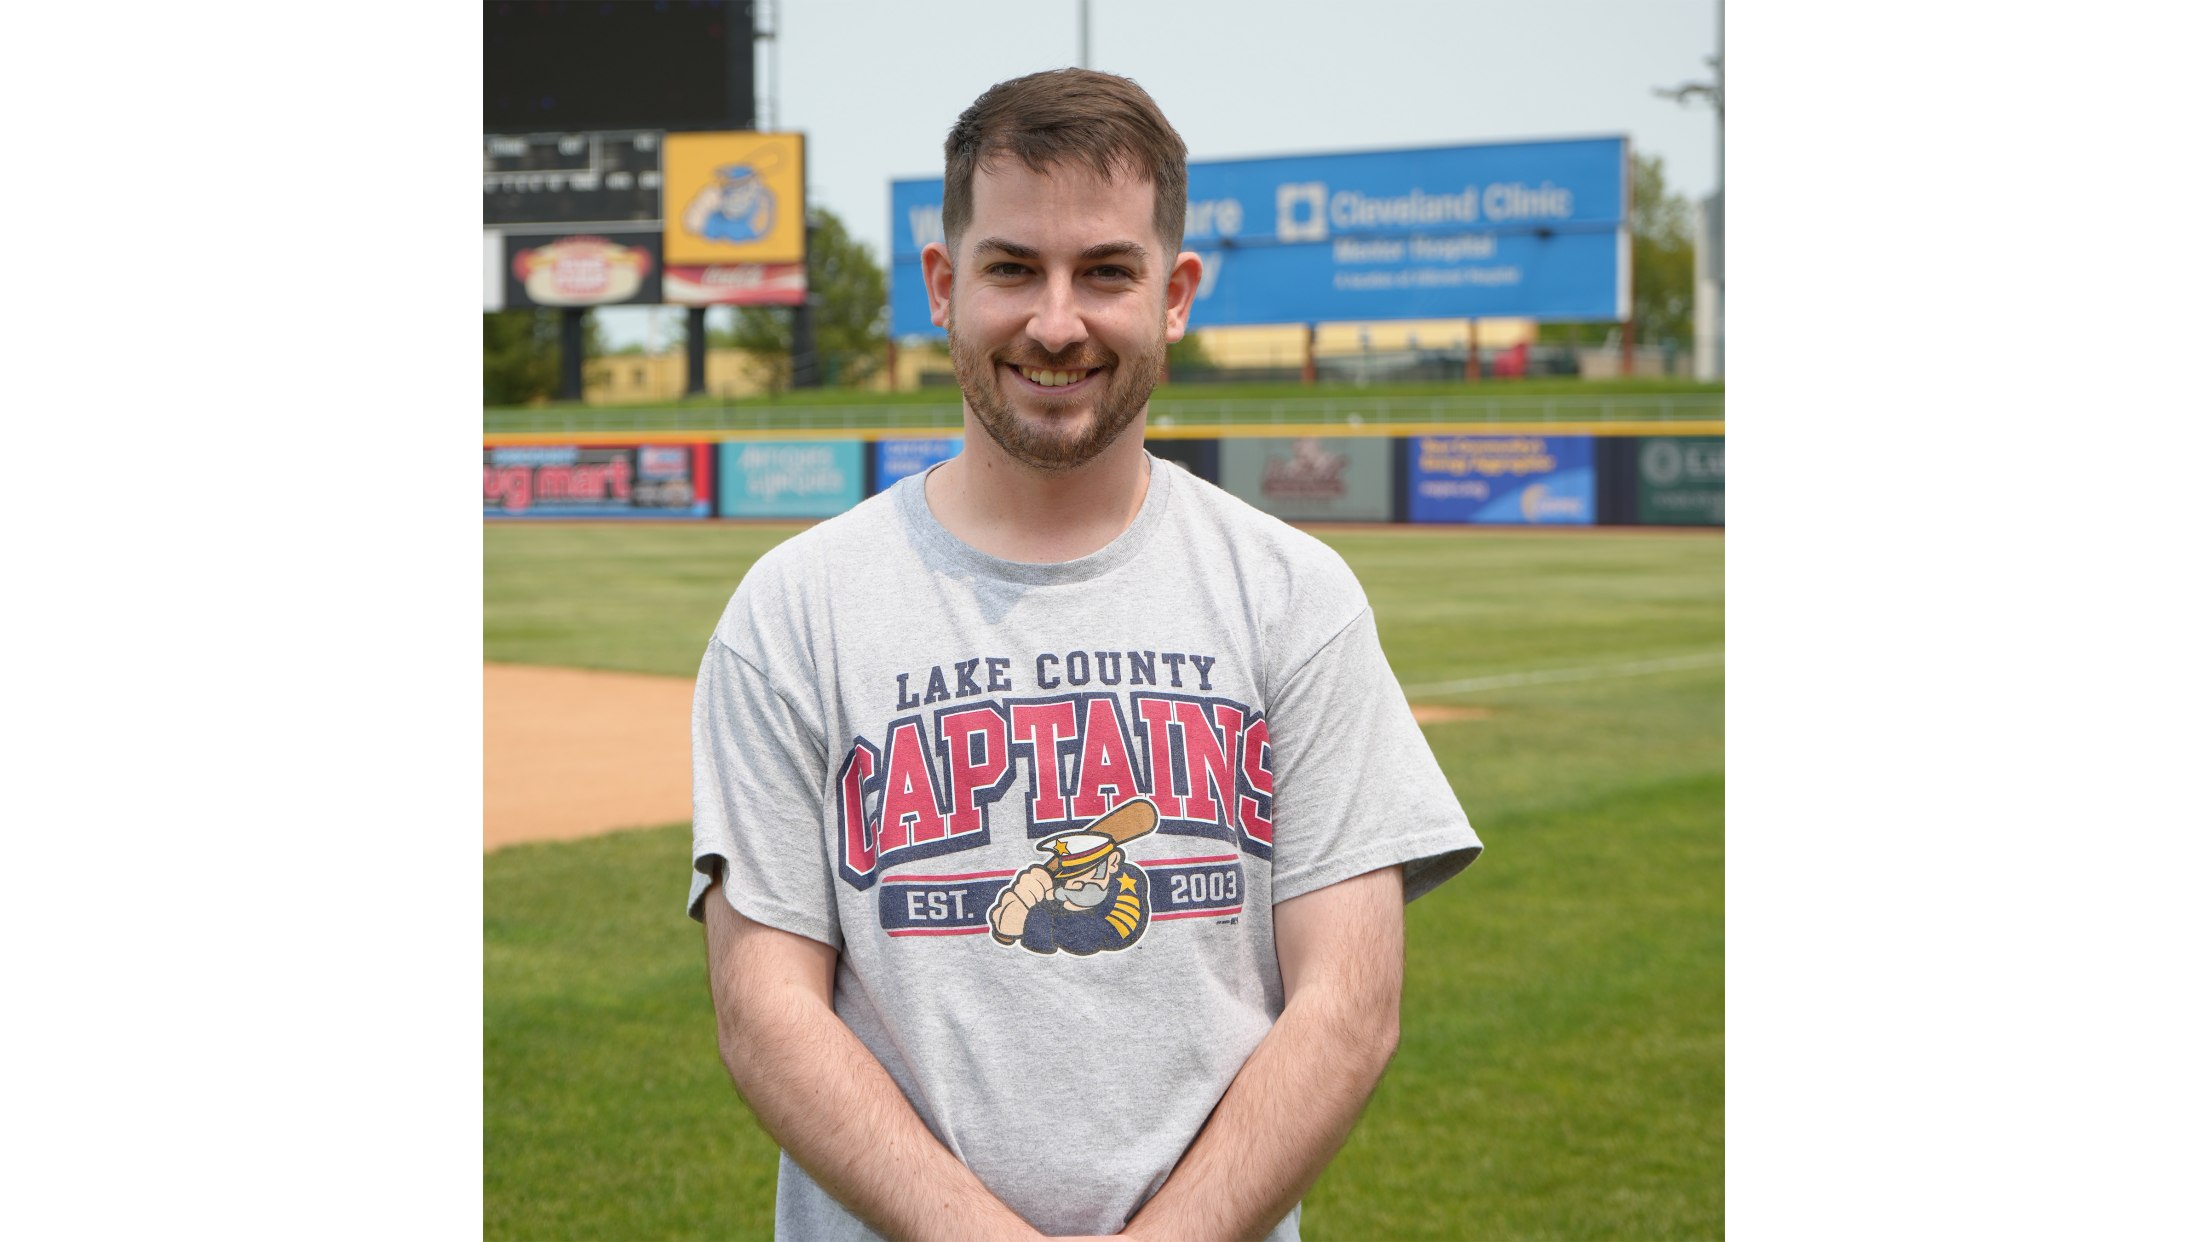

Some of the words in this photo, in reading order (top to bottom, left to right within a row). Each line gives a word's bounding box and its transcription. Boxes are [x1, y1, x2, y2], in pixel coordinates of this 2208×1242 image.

[1332, 187, 1479, 227] Cleveland
[1483, 182, 1573, 221] Clinic
[537, 456, 632, 500] mart
[896, 657, 1012, 711] LAKE
[1036, 650, 1216, 691] COUNTY
[838, 694, 1272, 889] CAPTAINS
[906, 889, 975, 921] EST.
[1171, 870, 1238, 905] 2003
